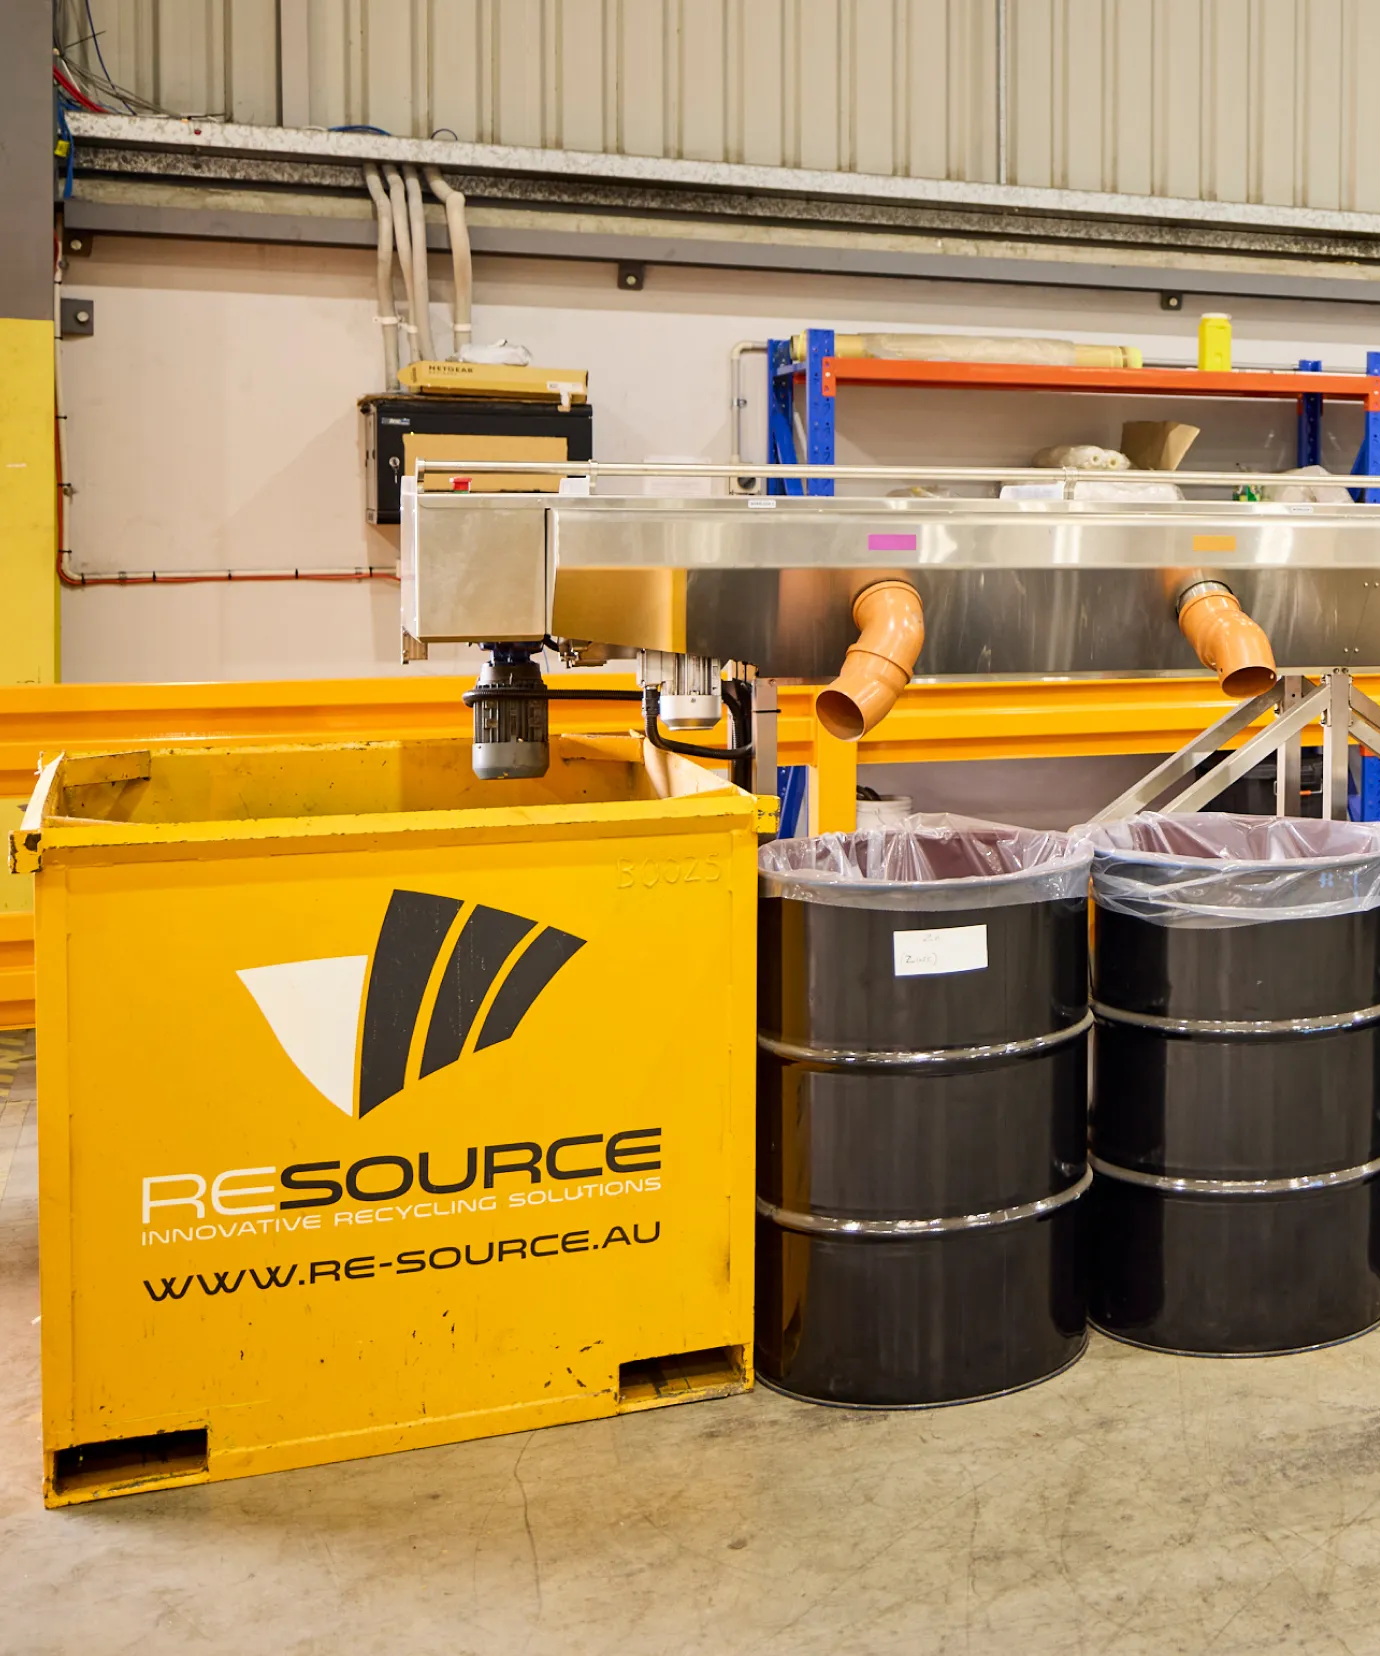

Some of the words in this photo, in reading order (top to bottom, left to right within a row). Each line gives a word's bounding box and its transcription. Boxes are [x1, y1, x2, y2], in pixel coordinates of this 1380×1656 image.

[428, 365, 474, 374] NETGEAR
[141, 1127, 662, 1224] RESOURCE
[141, 1213, 322, 1246] INNOVATIVE
[333, 1195, 497, 1227] RECYCLING
[508, 1175, 662, 1208] SOLUTIONS
[142, 1220, 662, 1302] WWW.RE-SOURCE.AU
